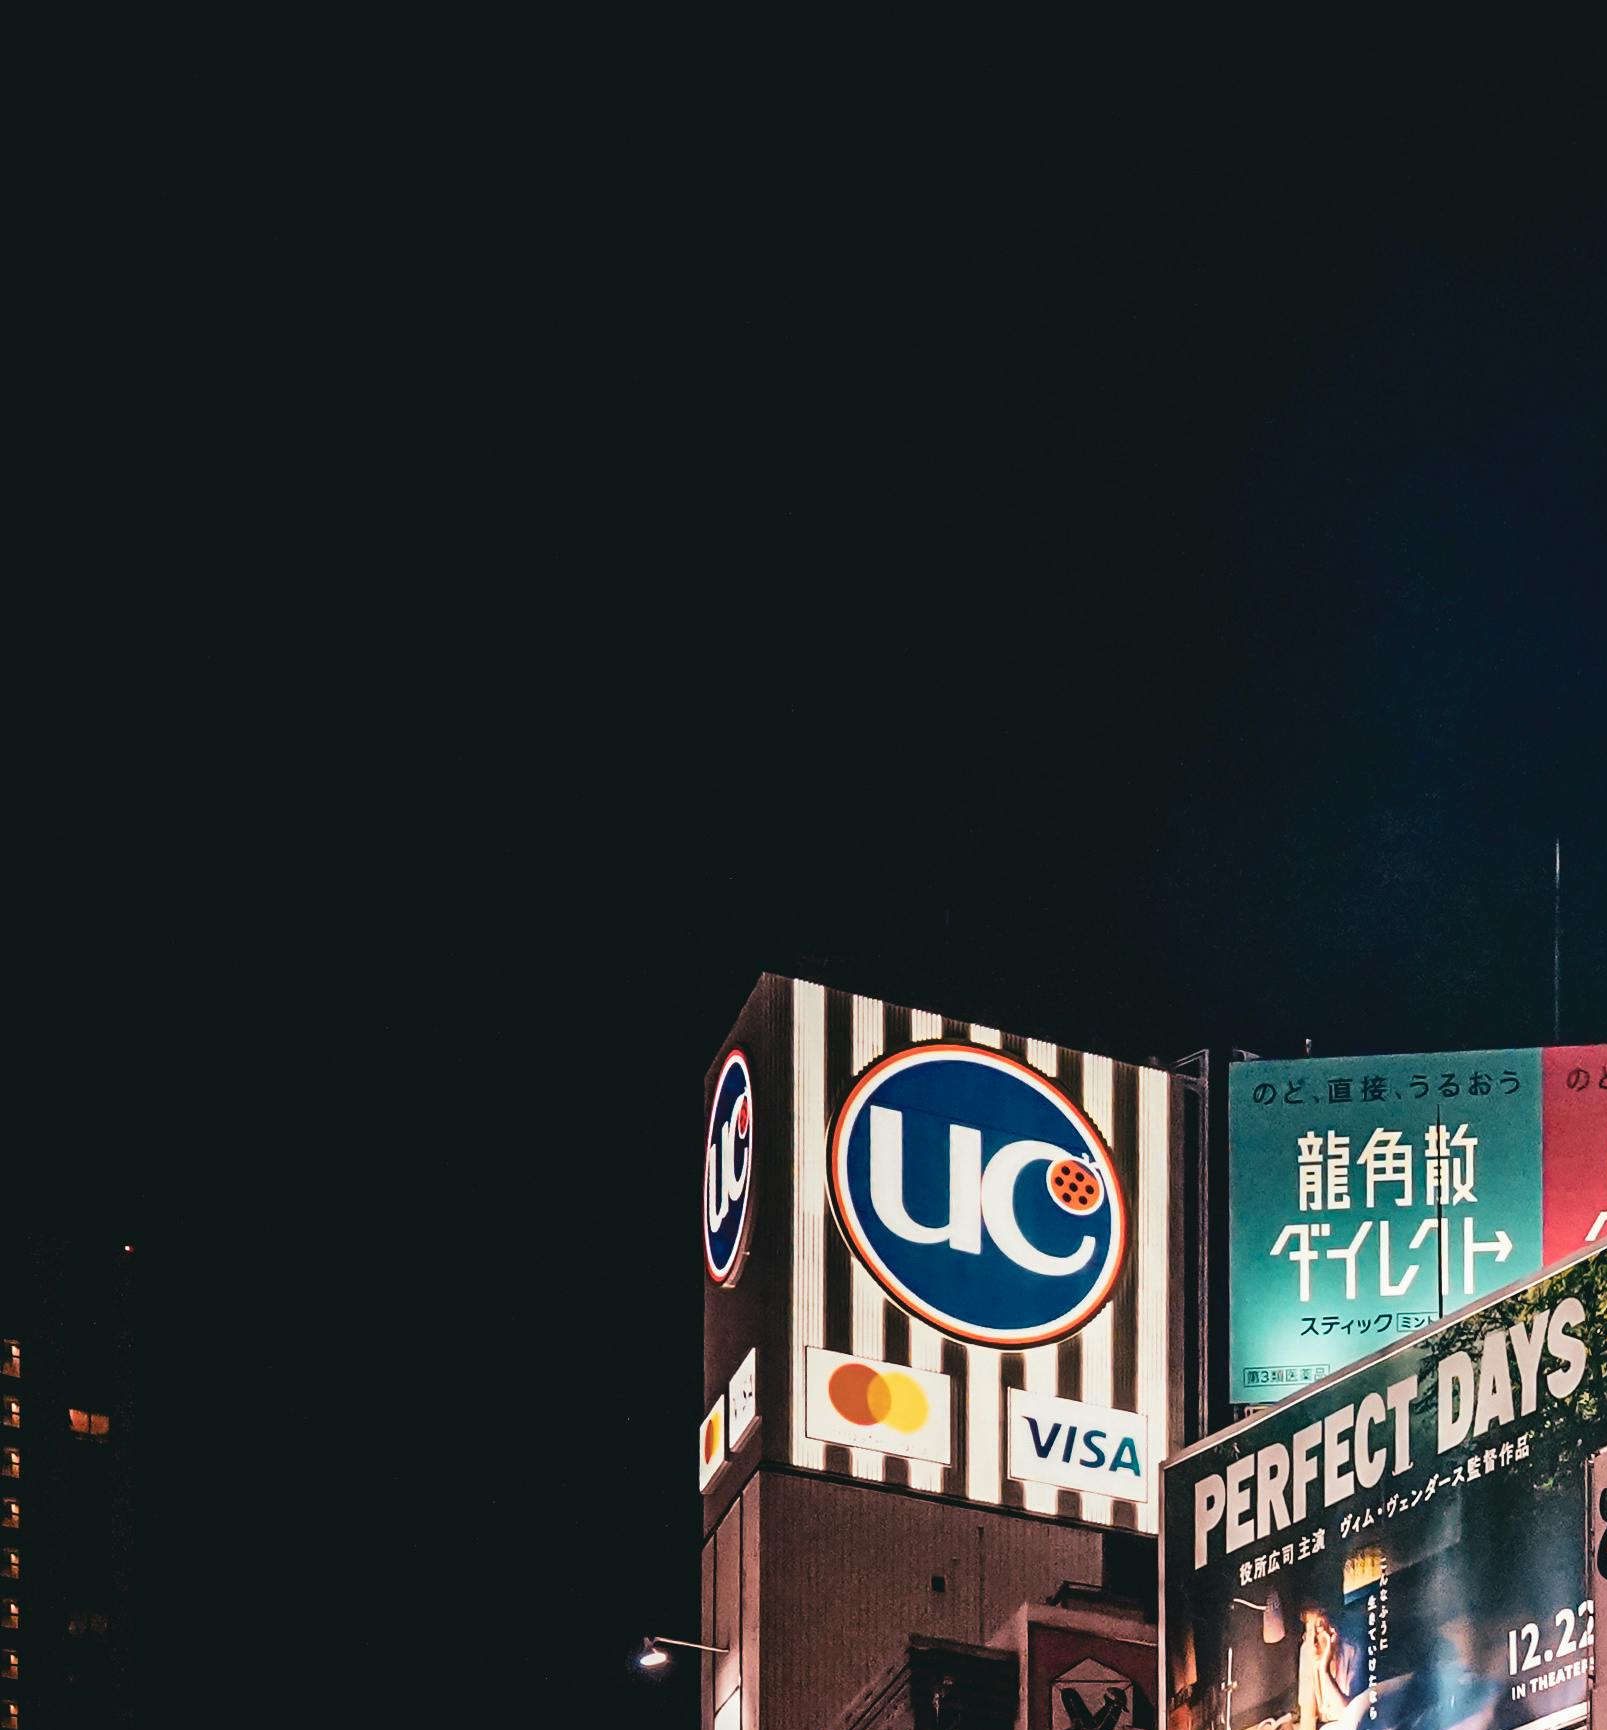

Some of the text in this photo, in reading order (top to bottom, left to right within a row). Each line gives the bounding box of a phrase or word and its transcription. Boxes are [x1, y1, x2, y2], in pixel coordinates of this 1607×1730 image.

[1253, 1069, 1521, 1107] のど、直接、うるおう
[1298, 1123, 1479, 1211] 龍角散
[1270, 1216, 1513, 1302] ダイレクト
[1300, 1312, 1394, 1337] スティック
[1022, 1415, 1141, 1477] VISA
[1194, 1297, 1587, 1570] PERFECT DAYS
[1511, 1682, 1526, 1703] IN
